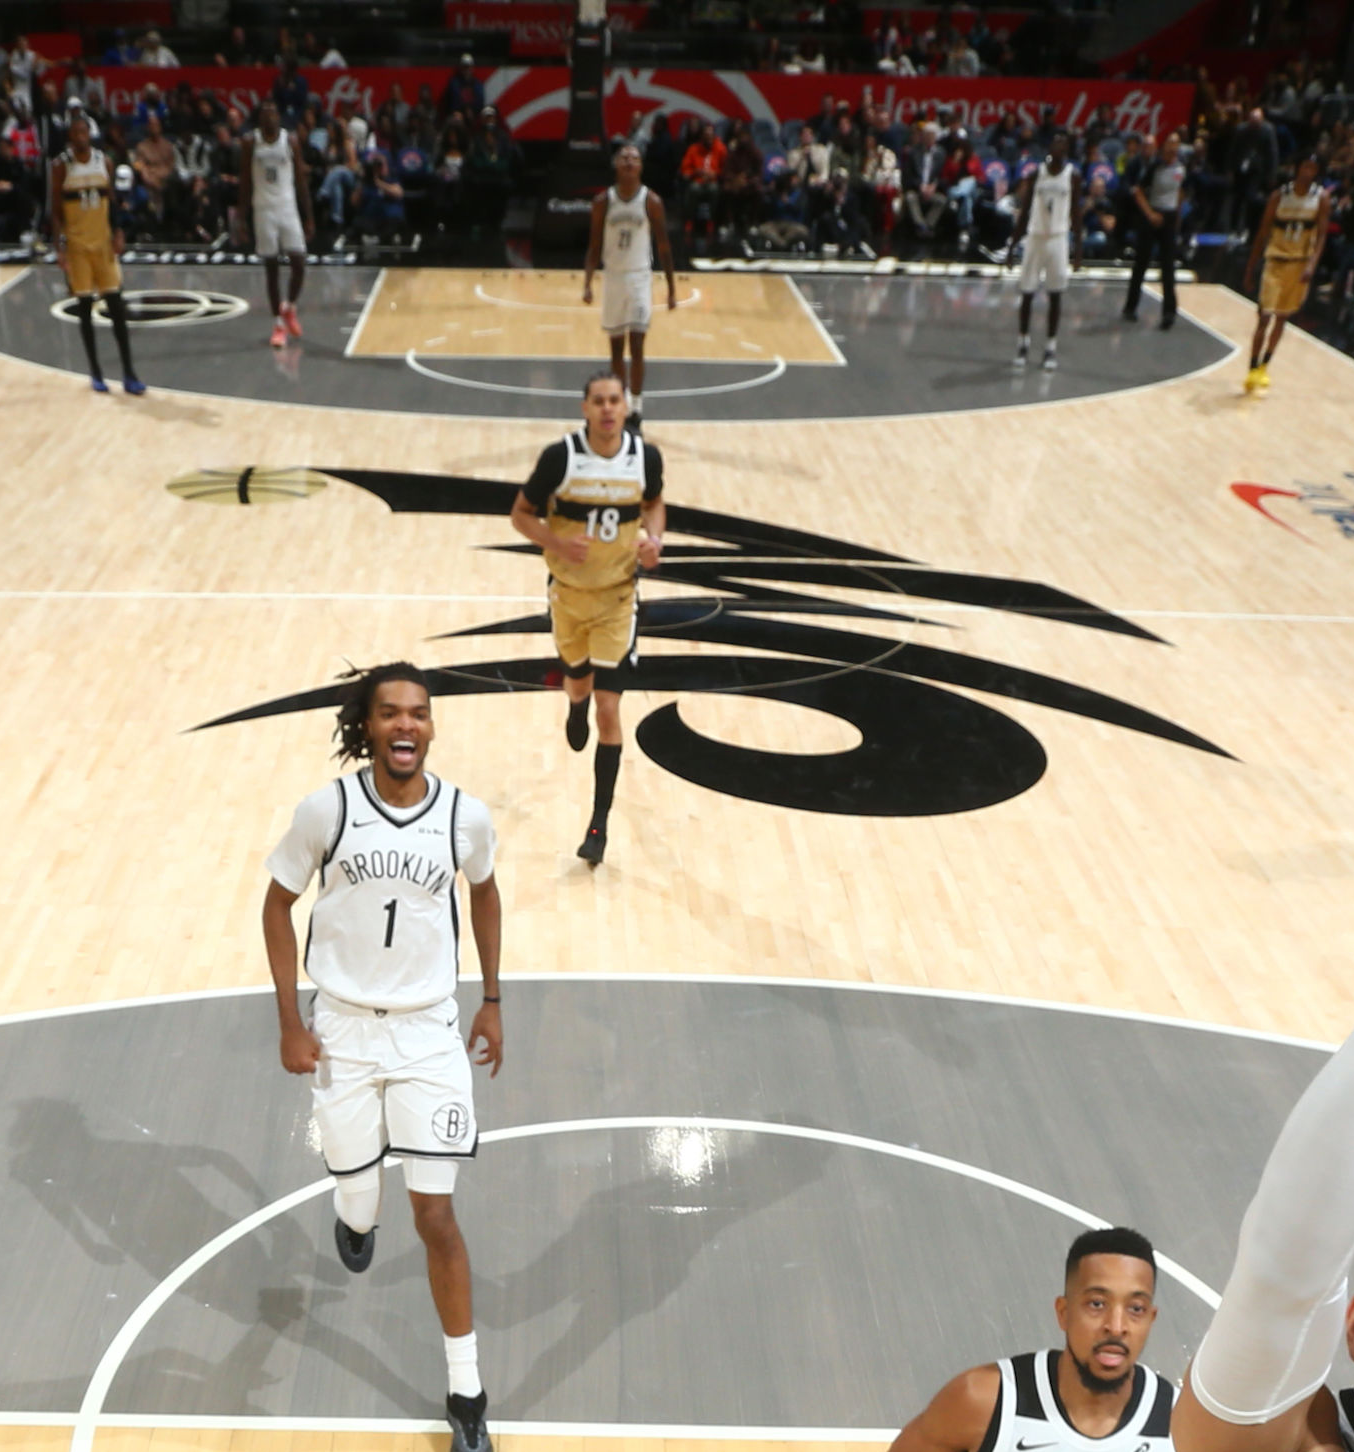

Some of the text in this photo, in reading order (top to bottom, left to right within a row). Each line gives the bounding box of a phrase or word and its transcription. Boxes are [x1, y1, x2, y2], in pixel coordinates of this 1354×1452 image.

[586, 507, 621, 543] 18
[339, 849, 451, 896] BROOKLYN
[382, 898, 398, 949] 1
